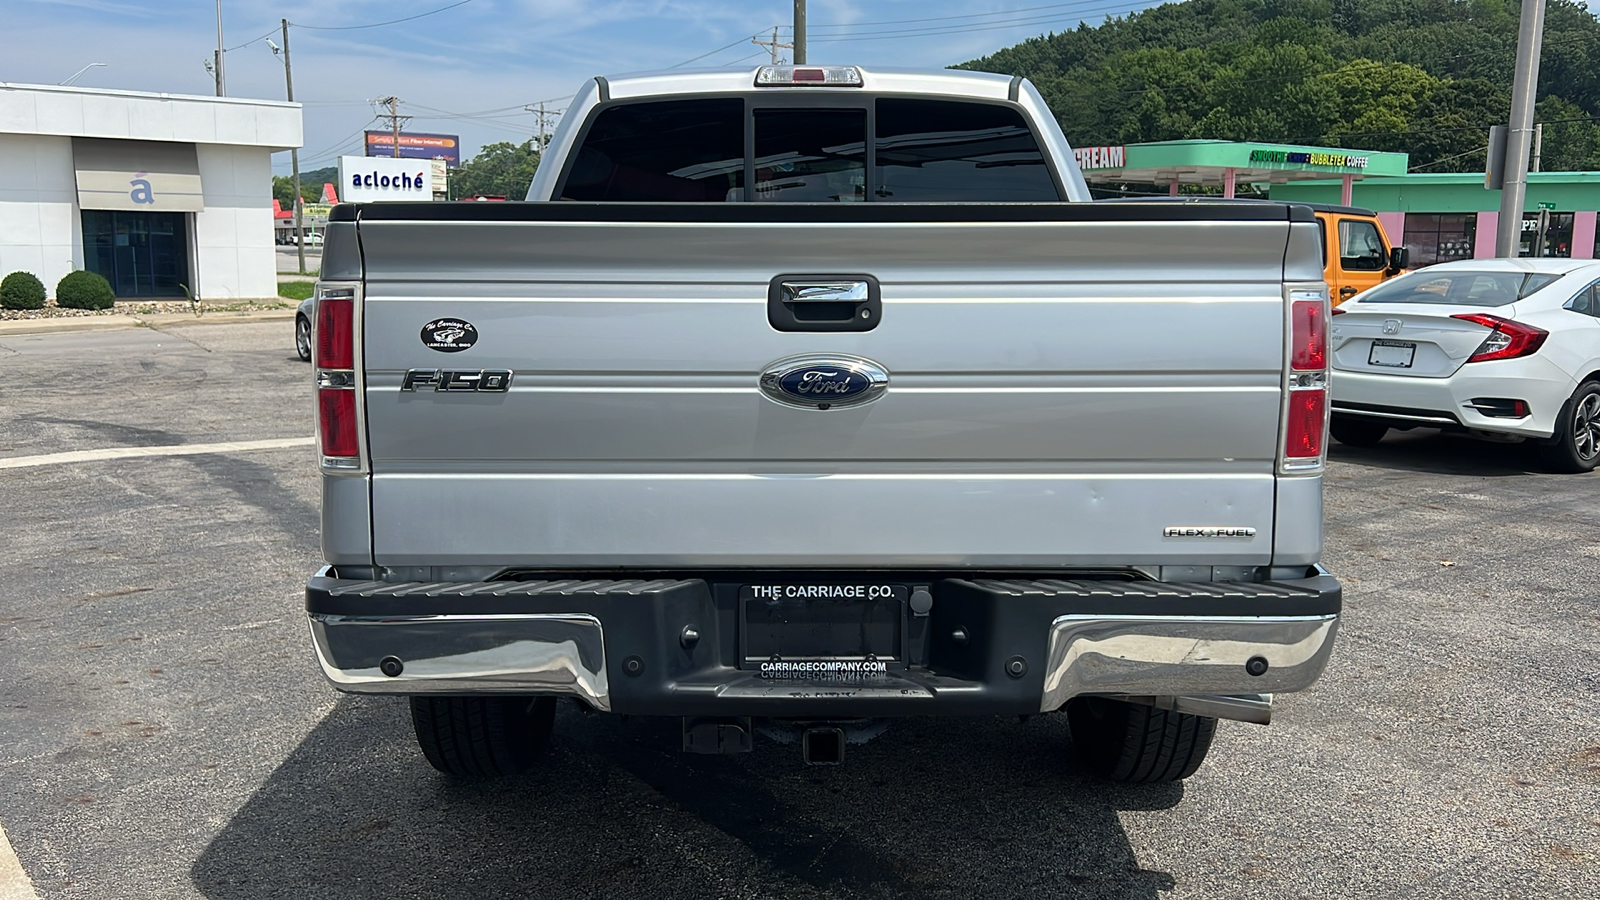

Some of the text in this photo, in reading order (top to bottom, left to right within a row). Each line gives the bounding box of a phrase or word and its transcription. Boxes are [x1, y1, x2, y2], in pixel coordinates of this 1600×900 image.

[1073, 146, 1124, 169] CREAM
[1346, 156, 1368, 168] COFFEE
[352, 171, 424, 189] acloché
[437, 320, 463, 329] Carriage
[797, 370, 851, 394] Ford
[1169, 529, 1254, 537] FLEX FUEL
[751, 585, 895, 598] THE CARRIAGE CO.
[760, 662, 887, 672] CARRIAGECOMPANY.COM
